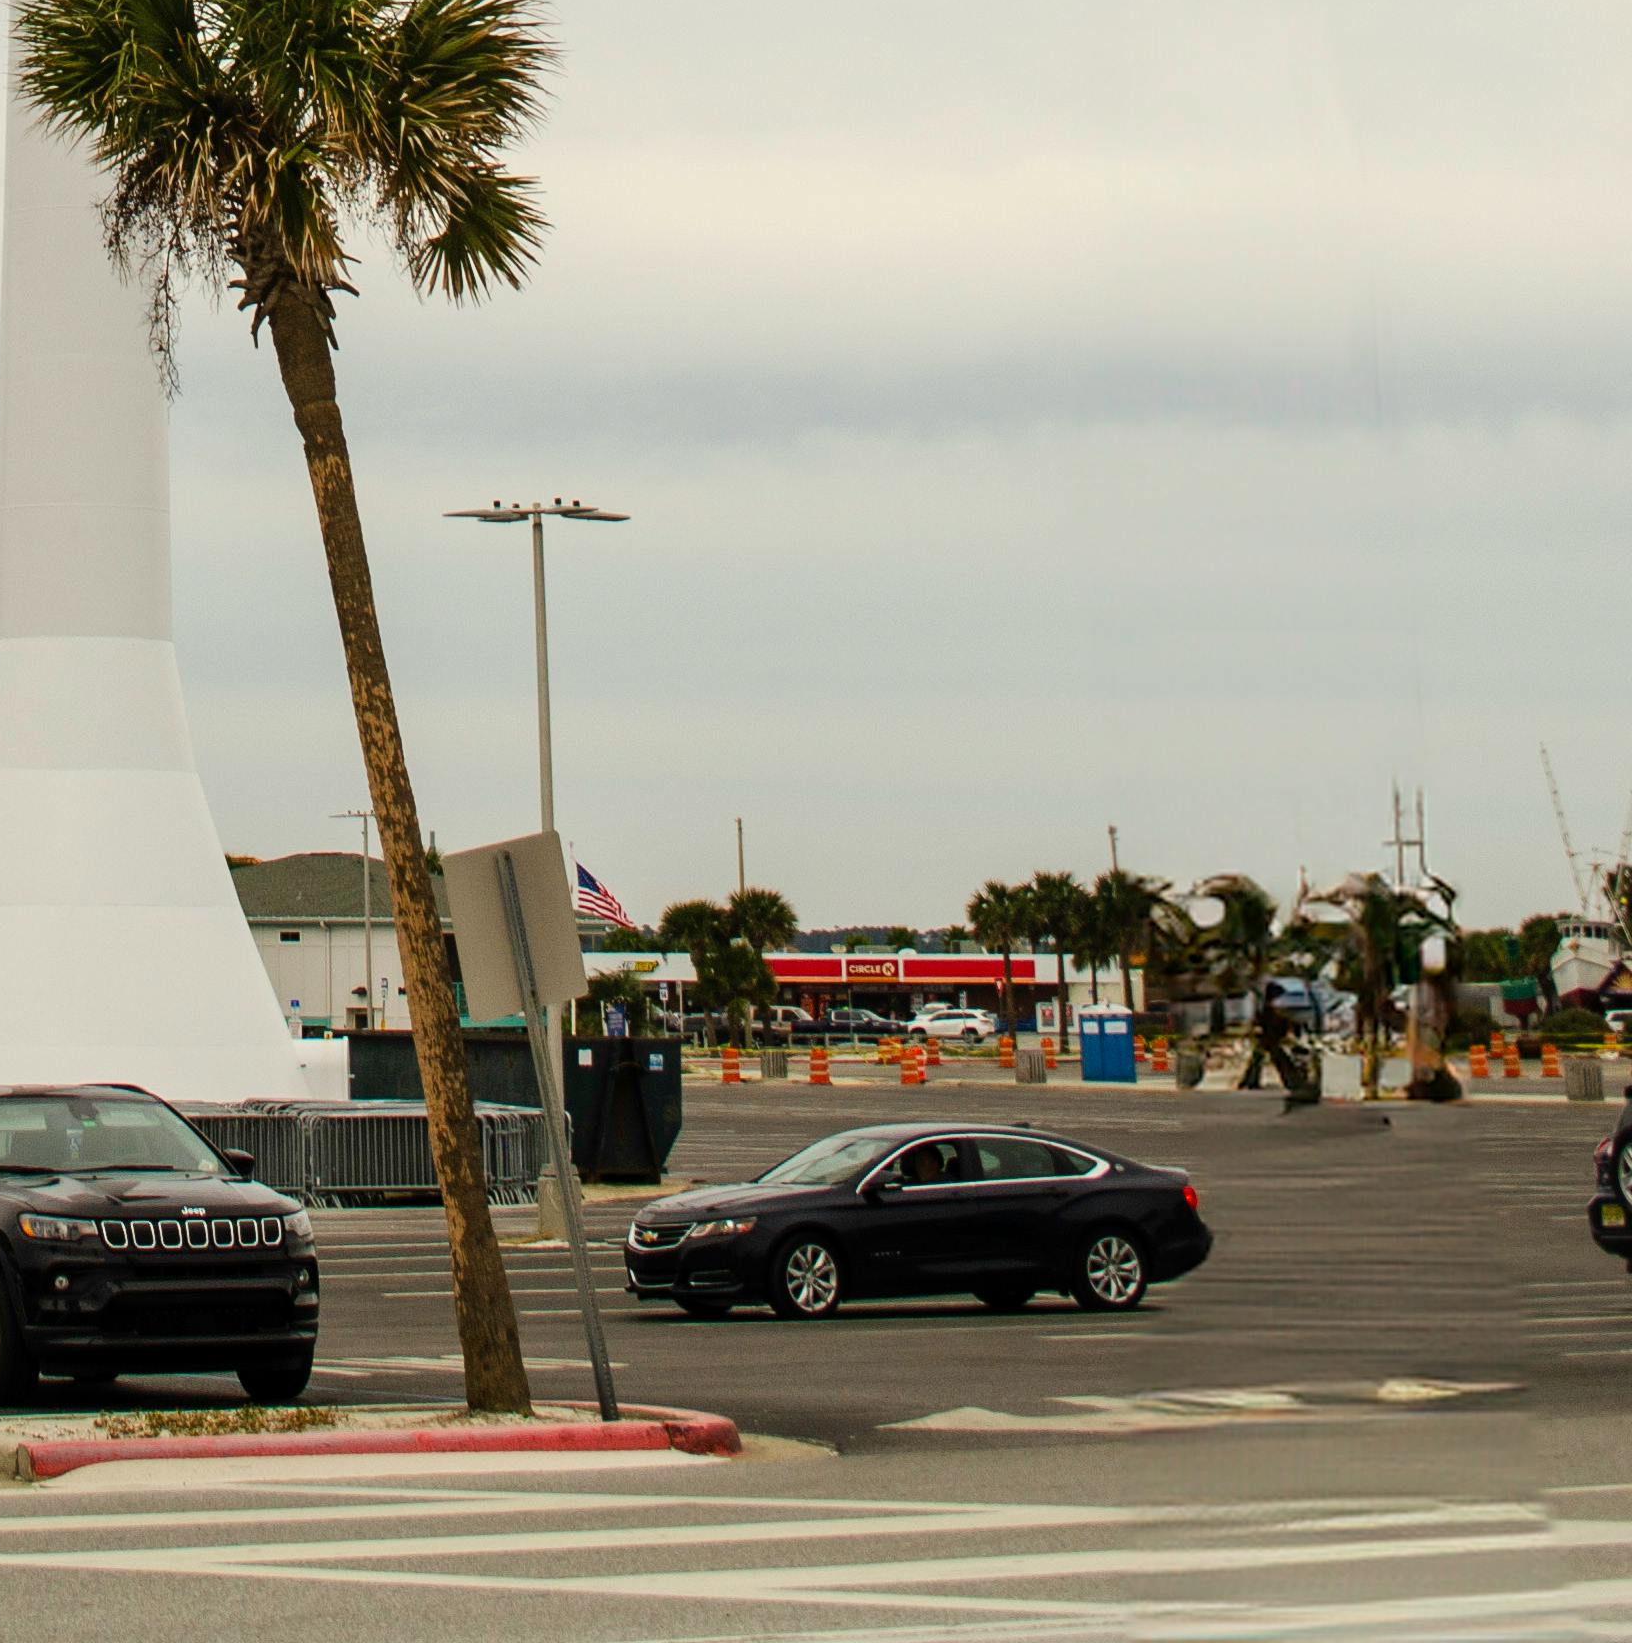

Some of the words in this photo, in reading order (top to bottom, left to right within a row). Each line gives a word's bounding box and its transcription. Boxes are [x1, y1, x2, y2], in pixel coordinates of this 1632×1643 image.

[848, 964, 881, 974] CIRCLE
[882, 962, 895, 976] K
[181, 1205, 206, 1216] Jeep
